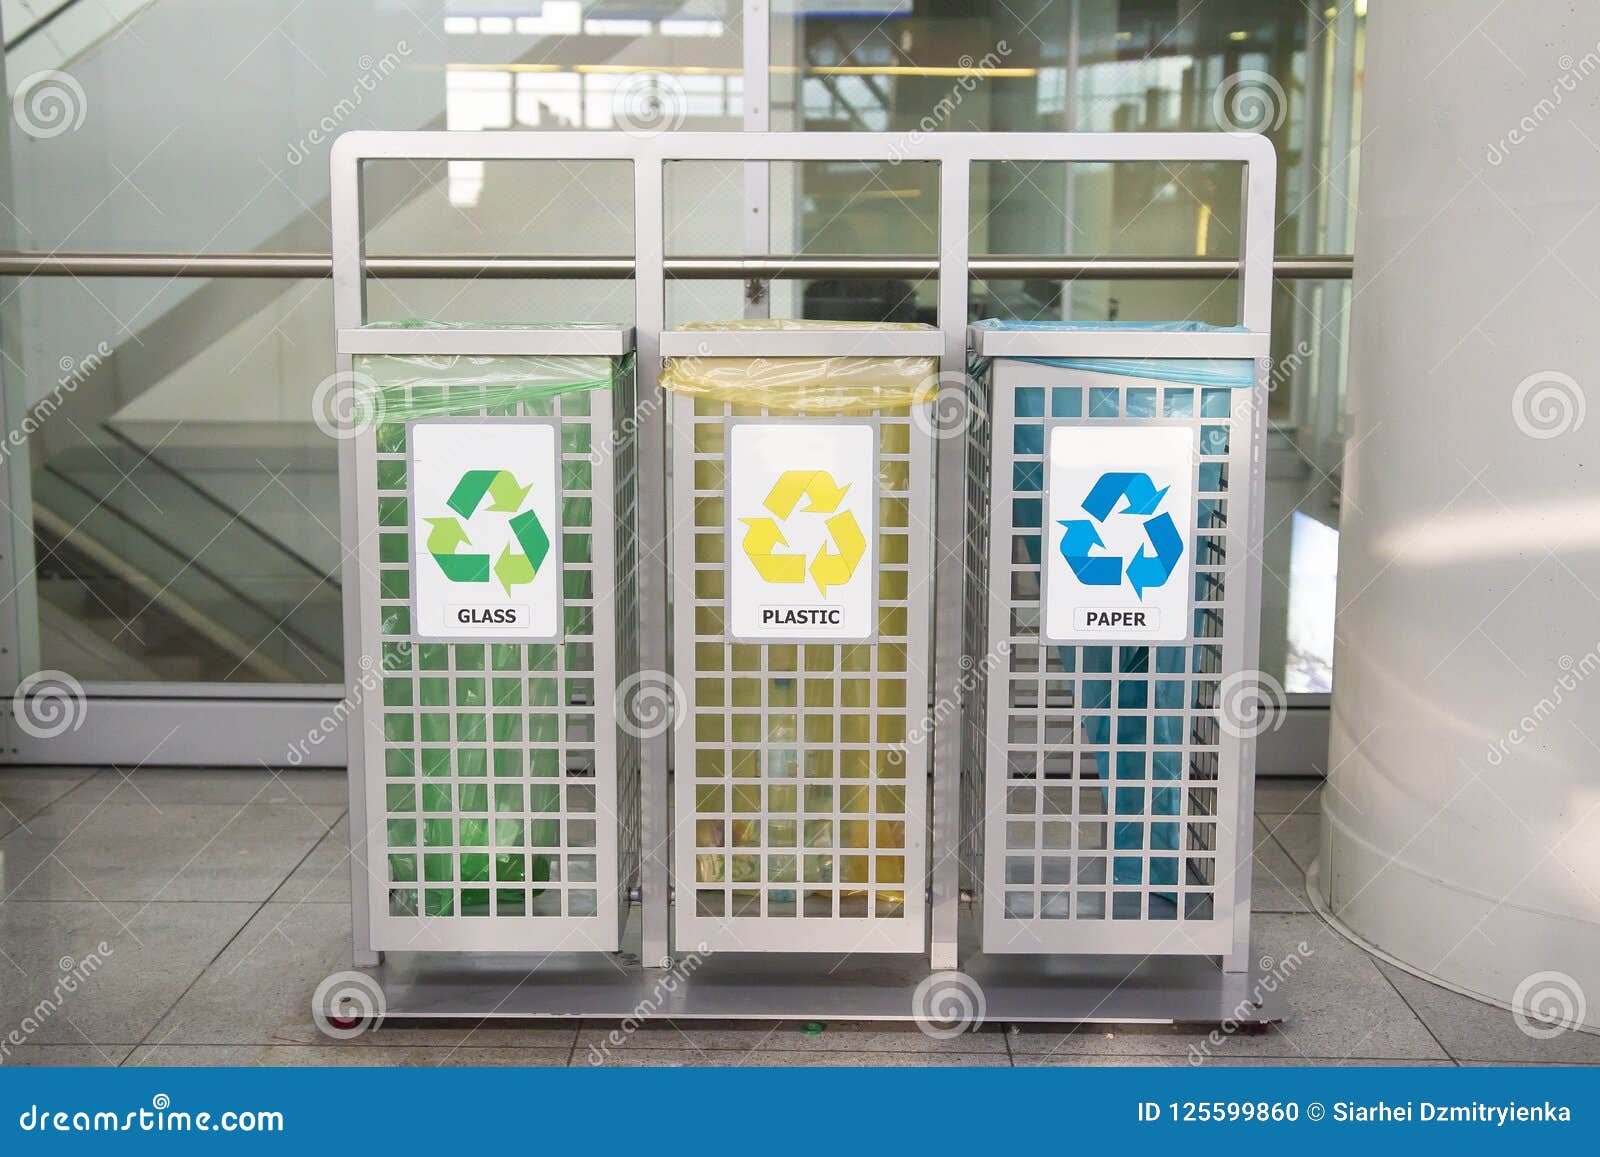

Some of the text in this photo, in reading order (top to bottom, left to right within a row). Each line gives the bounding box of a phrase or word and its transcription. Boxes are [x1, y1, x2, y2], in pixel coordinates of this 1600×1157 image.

[457, 608, 517, 624] GLASS
[763, 609, 840, 625] PLASTIC
[1086, 611, 1146, 627] PAPER
